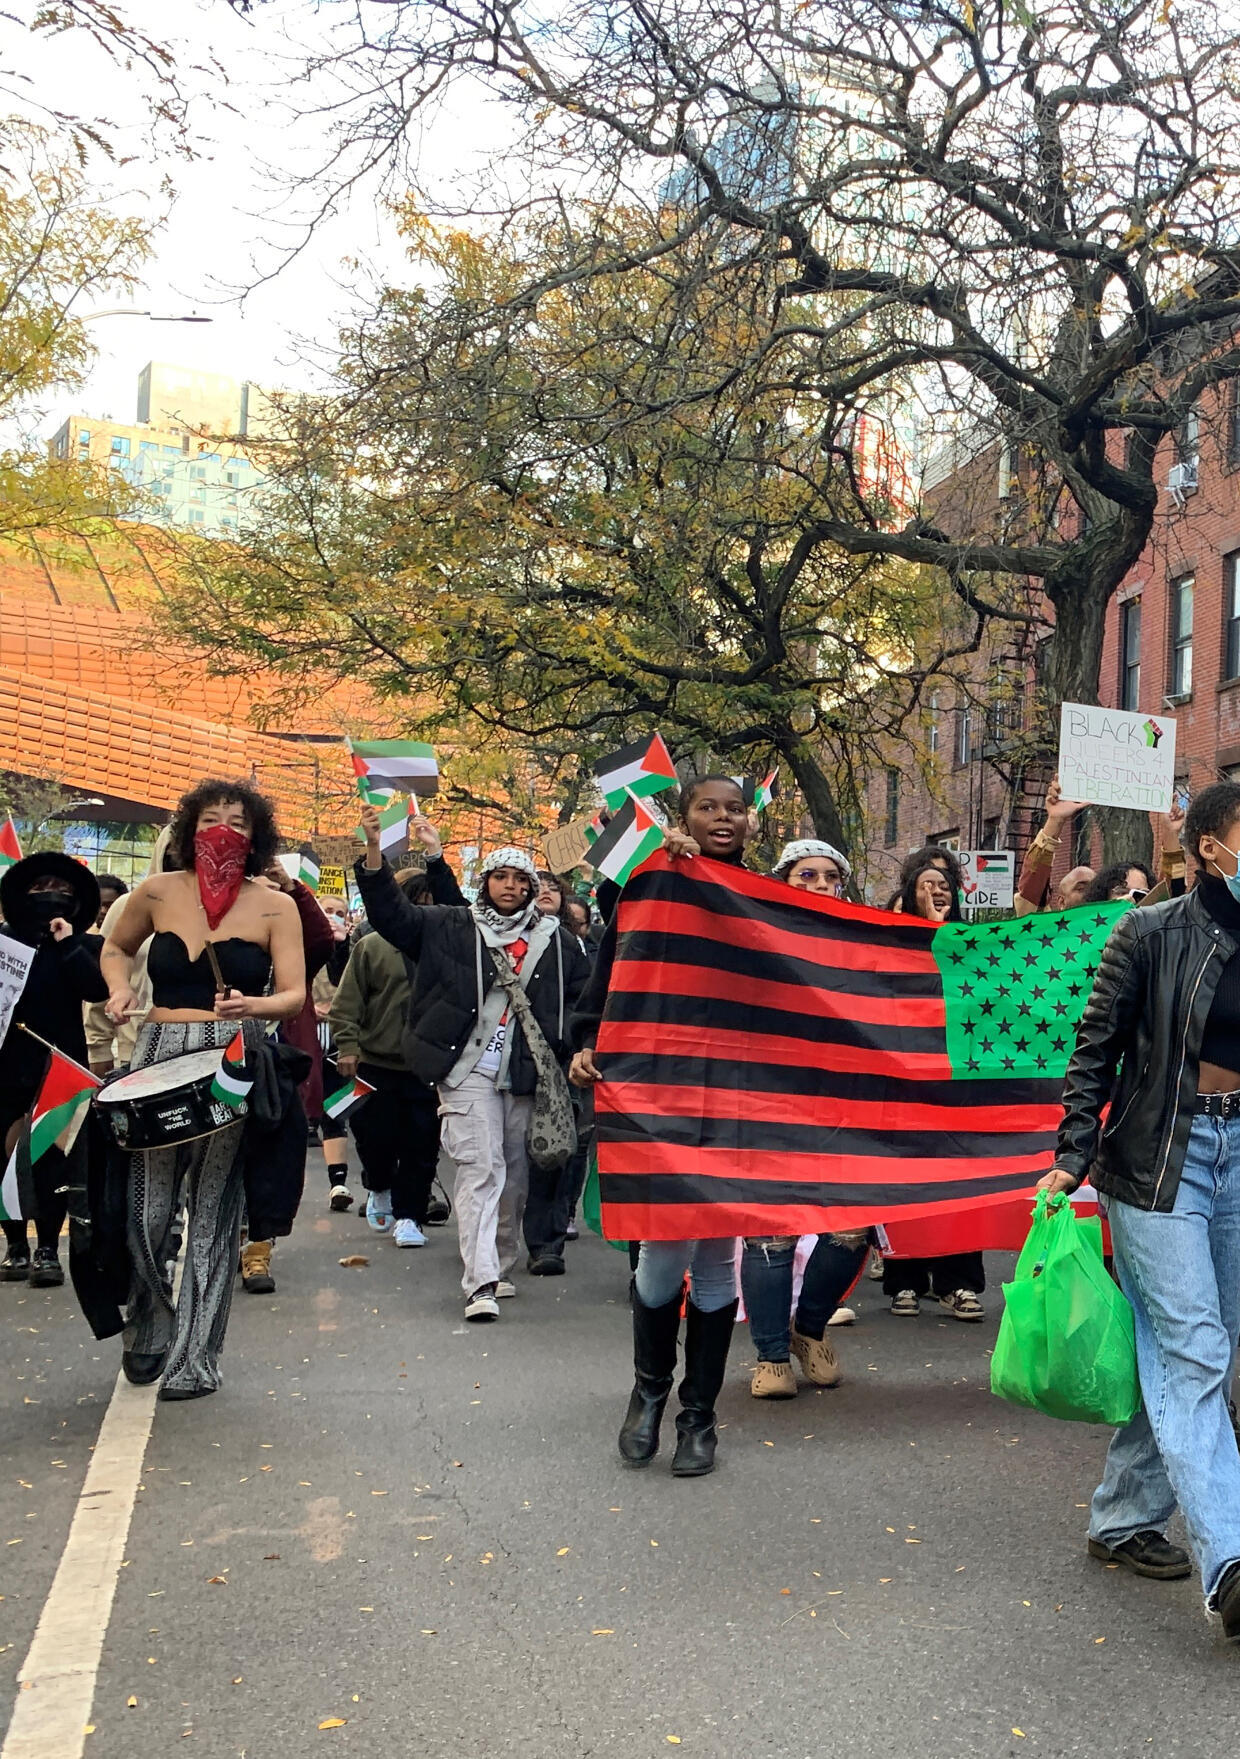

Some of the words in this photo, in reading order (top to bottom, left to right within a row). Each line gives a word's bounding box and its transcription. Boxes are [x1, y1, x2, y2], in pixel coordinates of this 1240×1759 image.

[1067, 710, 1143, 747] BLACK
[1069, 736, 1146, 766] QUEERS
[1152, 752, 1163, 768] 4
[1061, 755, 1173, 788] PALESTINIAN
[1061, 775, 1172, 808] LIBERATION
[319, 868, 344, 877] TANCE
[319, 877, 336, 885] INST
[965, 891, 999, 906] CIDE
[0, 960, 25, 980] STINE
[7, 954, 28, 970] WITH
[157, 1106, 189, 1119] UNFUCK
[164, 1119, 192, 1131] WORLD
